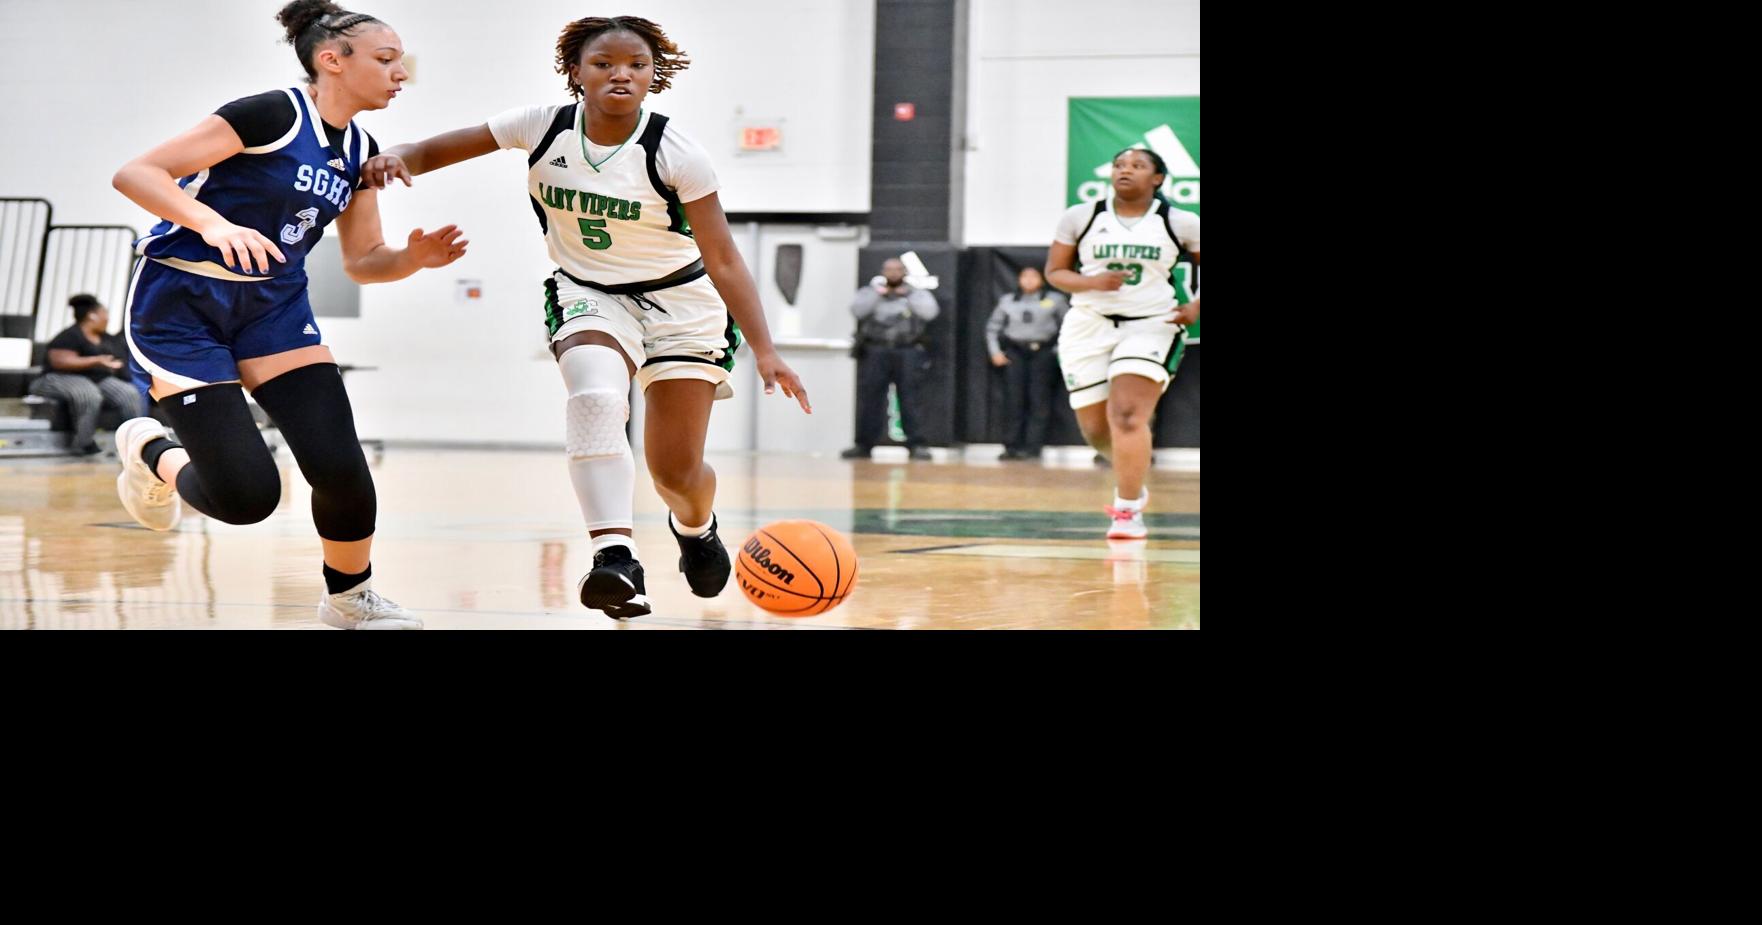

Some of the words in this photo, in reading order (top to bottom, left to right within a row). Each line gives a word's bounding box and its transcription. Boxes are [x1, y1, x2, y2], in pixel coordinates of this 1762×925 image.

[294, 164, 352, 212] SGHS
[539, 182, 577, 212] LADY
[579, 191, 642, 221] VIPERS
[280, 207, 319, 245] 3
[578, 218, 612, 250] 5
[1093, 244, 1119, 259] LADY
[1122, 244, 1161, 260] VIPERS
[743, 536, 795, 585] Wilson
